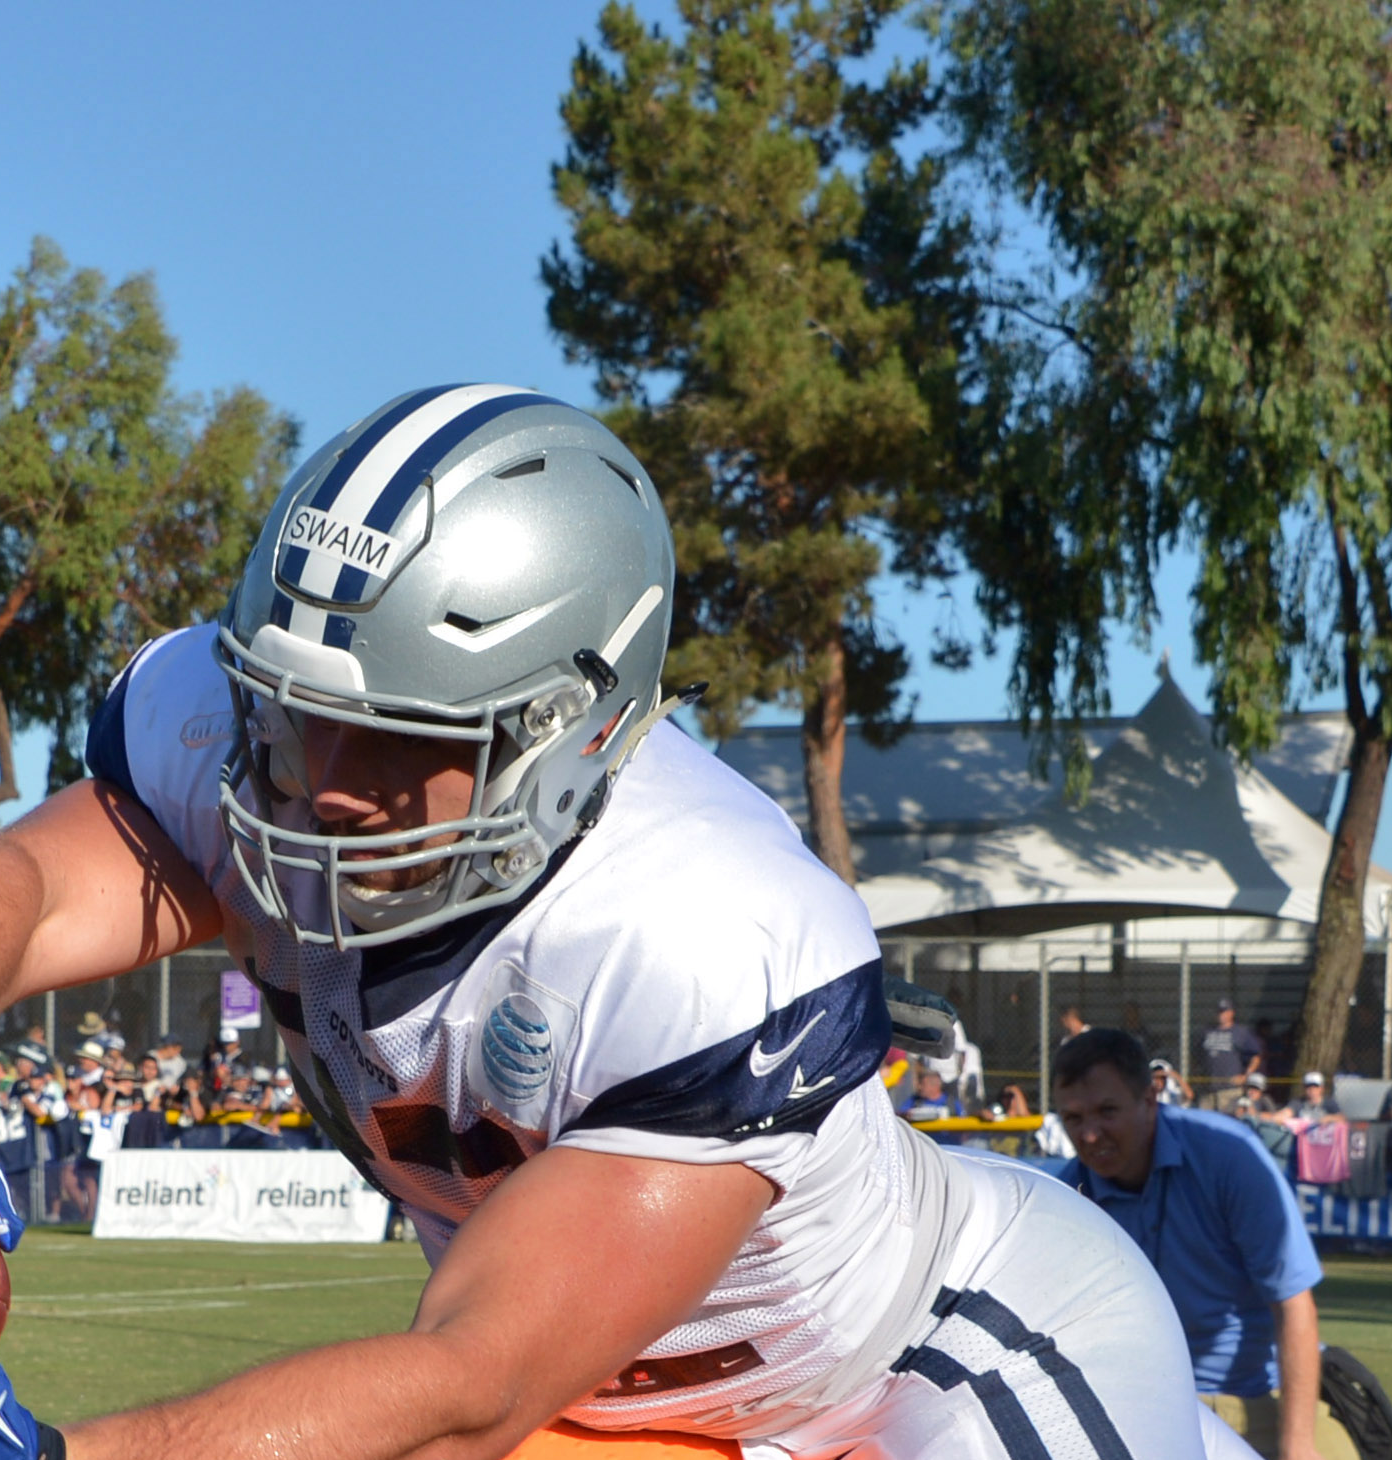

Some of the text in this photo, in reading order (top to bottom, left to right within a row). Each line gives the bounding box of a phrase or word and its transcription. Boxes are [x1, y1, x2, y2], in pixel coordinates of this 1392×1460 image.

[289, 511, 392, 570] SWAIM
[116, 1180, 205, 1206] reliant
[257, 1181, 350, 1209] reliant
